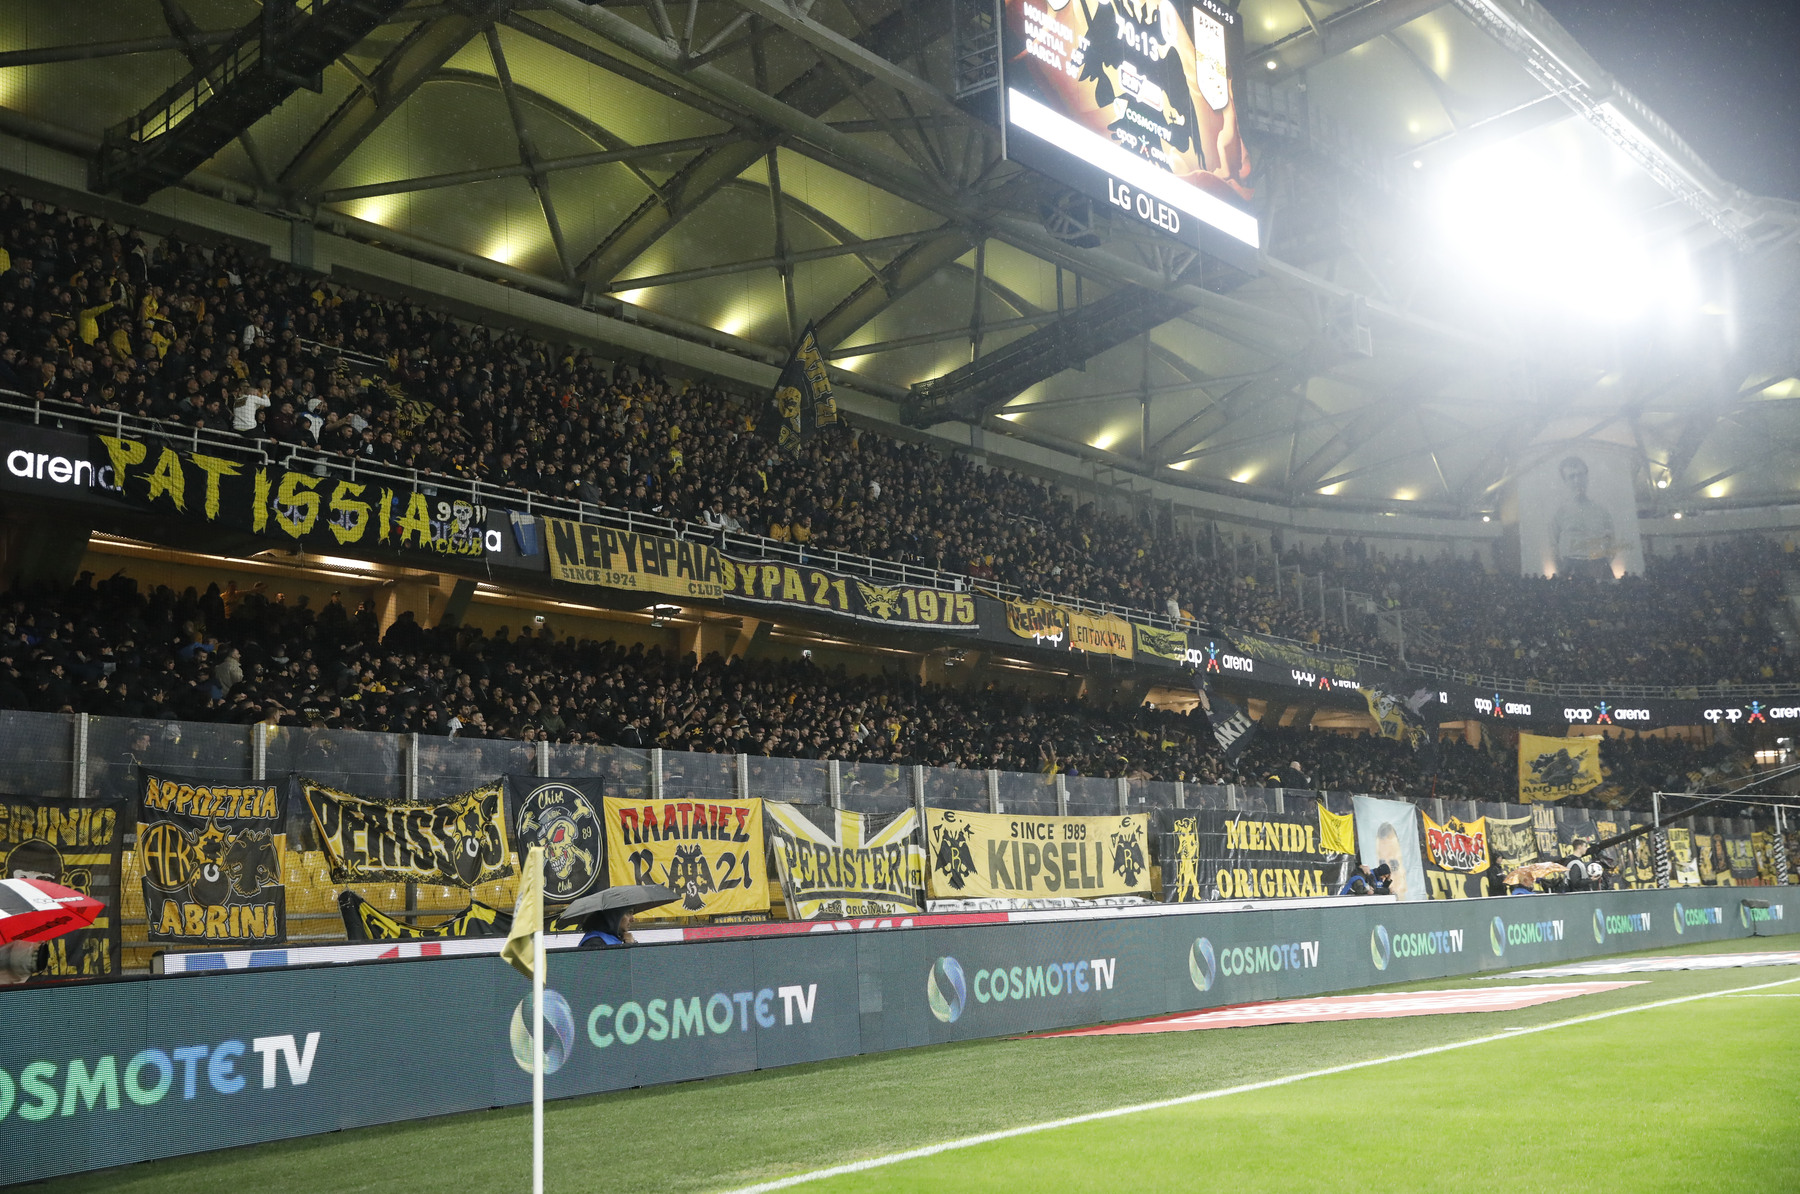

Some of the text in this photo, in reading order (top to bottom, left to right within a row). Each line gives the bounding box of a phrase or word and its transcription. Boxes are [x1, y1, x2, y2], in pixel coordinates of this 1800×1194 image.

[1115, 14, 1159, 62] 70:13
[1108, 177, 1180, 234] LG OLED
[98, 434, 434, 552] PATISSIA
[562, 567, 637, 587] SINCE 1974
[688, 582, 724, 597] CLUB
[810, 572, 849, 611] 21
[902, 588, 975, 623] 1975
[1222, 654, 1253, 672] arena
[1474, 698, 1532, 716] opap arena
[1564, 708, 1650, 722] opap arena
[146, 775, 279, 820] ΑΡΡΩΣΤΕΙΑ
[582, 826, 592, 840] 89
[619, 802, 752, 846] ΠΛΑΤΑΙΕΣ
[1010, 822, 1087, 841] SINCE 1989
[1225, 820, 1315, 854] MENIDI
[716, 850, 753, 892] 21
[987, 839, 1104, 892] KIPSELI
[1216, 868, 1328, 898] ORIGINAL
[1507, 919, 1564, 946] COSMOTE TV
[1606, 914, 1642, 934] COSMOTE
[1684, 908, 1716, 926] COSMOTE
[82, 938, 111, 975] 21
[1220, 940, 1320, 976] COSMOTE TV
[1392, 928, 1464, 958] COSMOTE TV
[974, 958, 1116, 1004] COSMOTE TV
[587, 984, 818, 1048] COSMOTE TV
[0, 1031, 320, 1121] SMOTE TV
